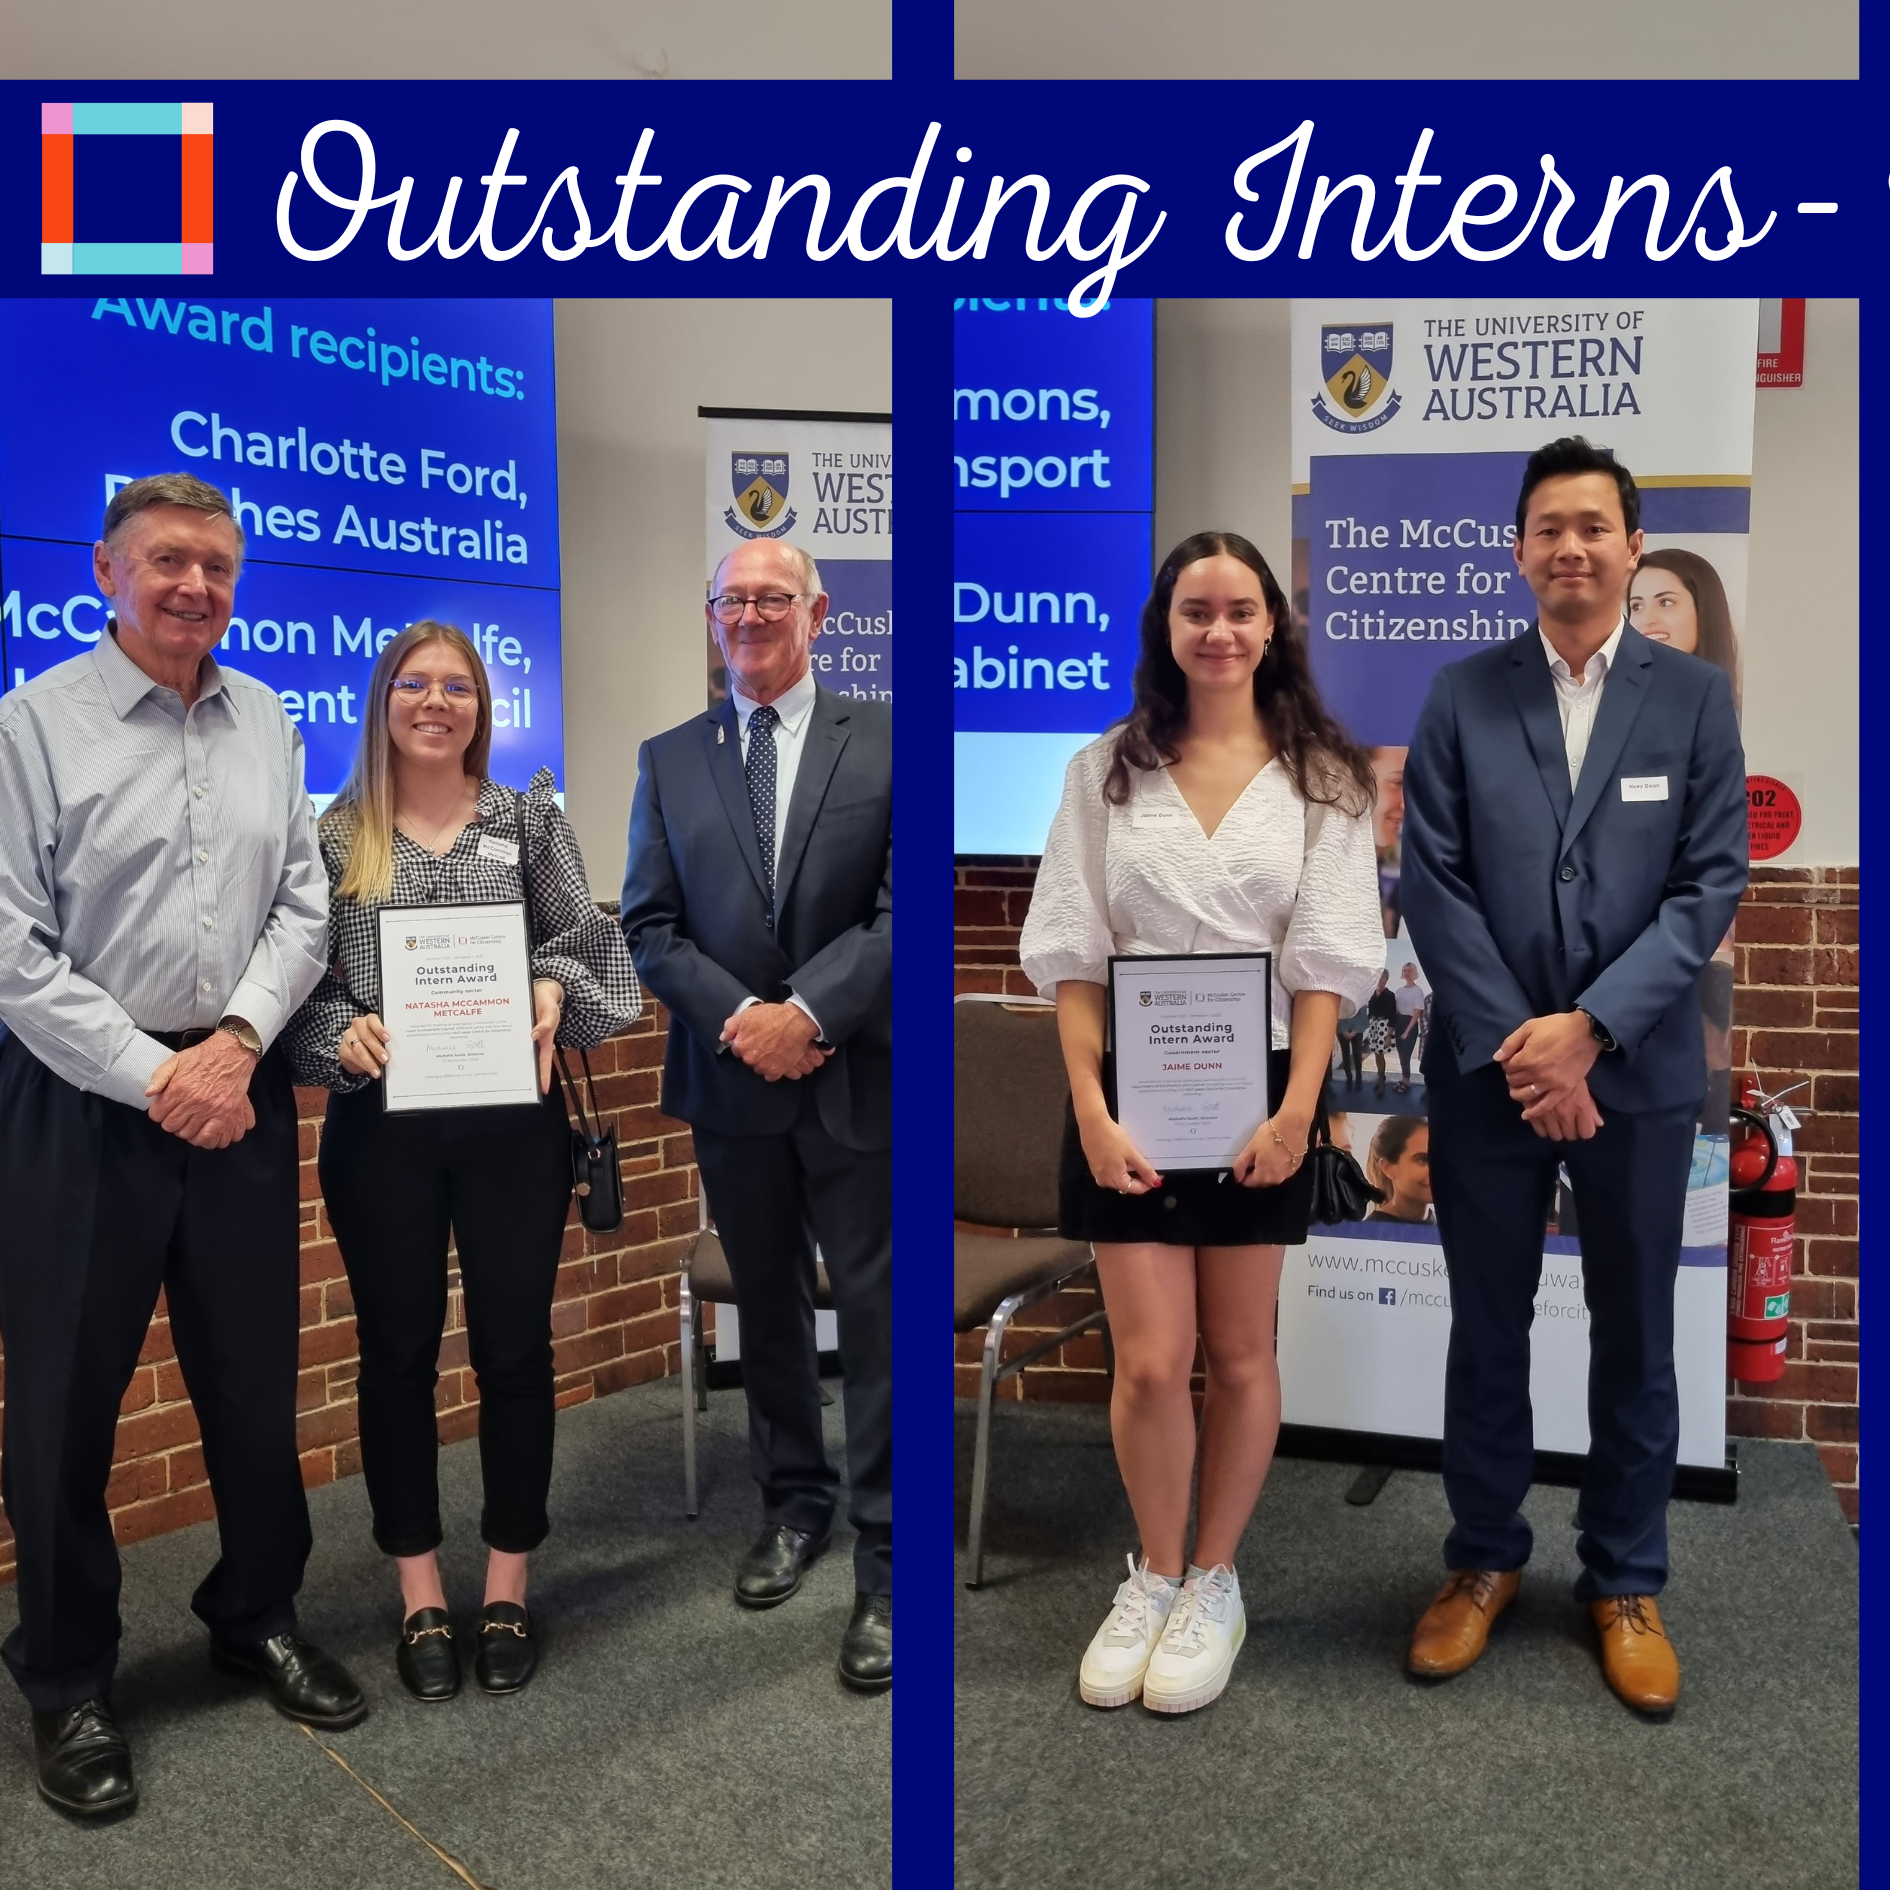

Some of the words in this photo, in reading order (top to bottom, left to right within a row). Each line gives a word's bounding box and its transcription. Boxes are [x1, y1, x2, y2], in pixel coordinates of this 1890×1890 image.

[1424, 319, 1465, 337] THE
[1475, 312, 1609, 336] UNIVERSITY
[1616, 311, 1644, 329] OF
[291, 327, 524, 400] recipients:
[1423, 336, 1643, 382] WESTERN
[1757, 358, 1778, 368] FIRE
[1422, 382, 1641, 421] AUSTRALIA
[1323, 415, 1345, 430] SEEK
[1350, 414, 1388, 432] WISDOM
[170, 410, 406, 485] Charlotte
[420, 449, 528, 509] Ford,
[812, 452, 843, 468] THE
[813, 508, 892, 535] AUST
[333, 504, 528, 564] Australia
[734, 525, 753, 538] SEEK
[1325, 517, 1389, 548] The
[1400, 519, 1517, 548] McCus
[1326, 566, 1445, 594] Centre
[1456, 563, 1511, 594] for
[954, 582, 1109, 632] Dunn,
[840, 647, 881, 672] for
[416, 963, 494, 975] Outstanding
[415, 976, 453, 986] Intern
[457, 973, 497, 984] Award
[405, 1001, 450, 1010] NATASHA
[452, 997, 510, 1008] MCCAMMON
[433, 1008, 483, 1017] METCALFE
[1151, 1022, 1232, 1034] Outstanding
[1149, 1036, 1188, 1045] Intern
[1193, 1033, 1234, 1043] Award
[1162, 1063, 1191, 1071] JAIME
[1194, 1062, 1223, 1070] DUNN
[1308, 1285, 1335, 1299] Find
[1340, 1291, 1354, 1300] us
[1358, 1291, 1374, 1302] on
